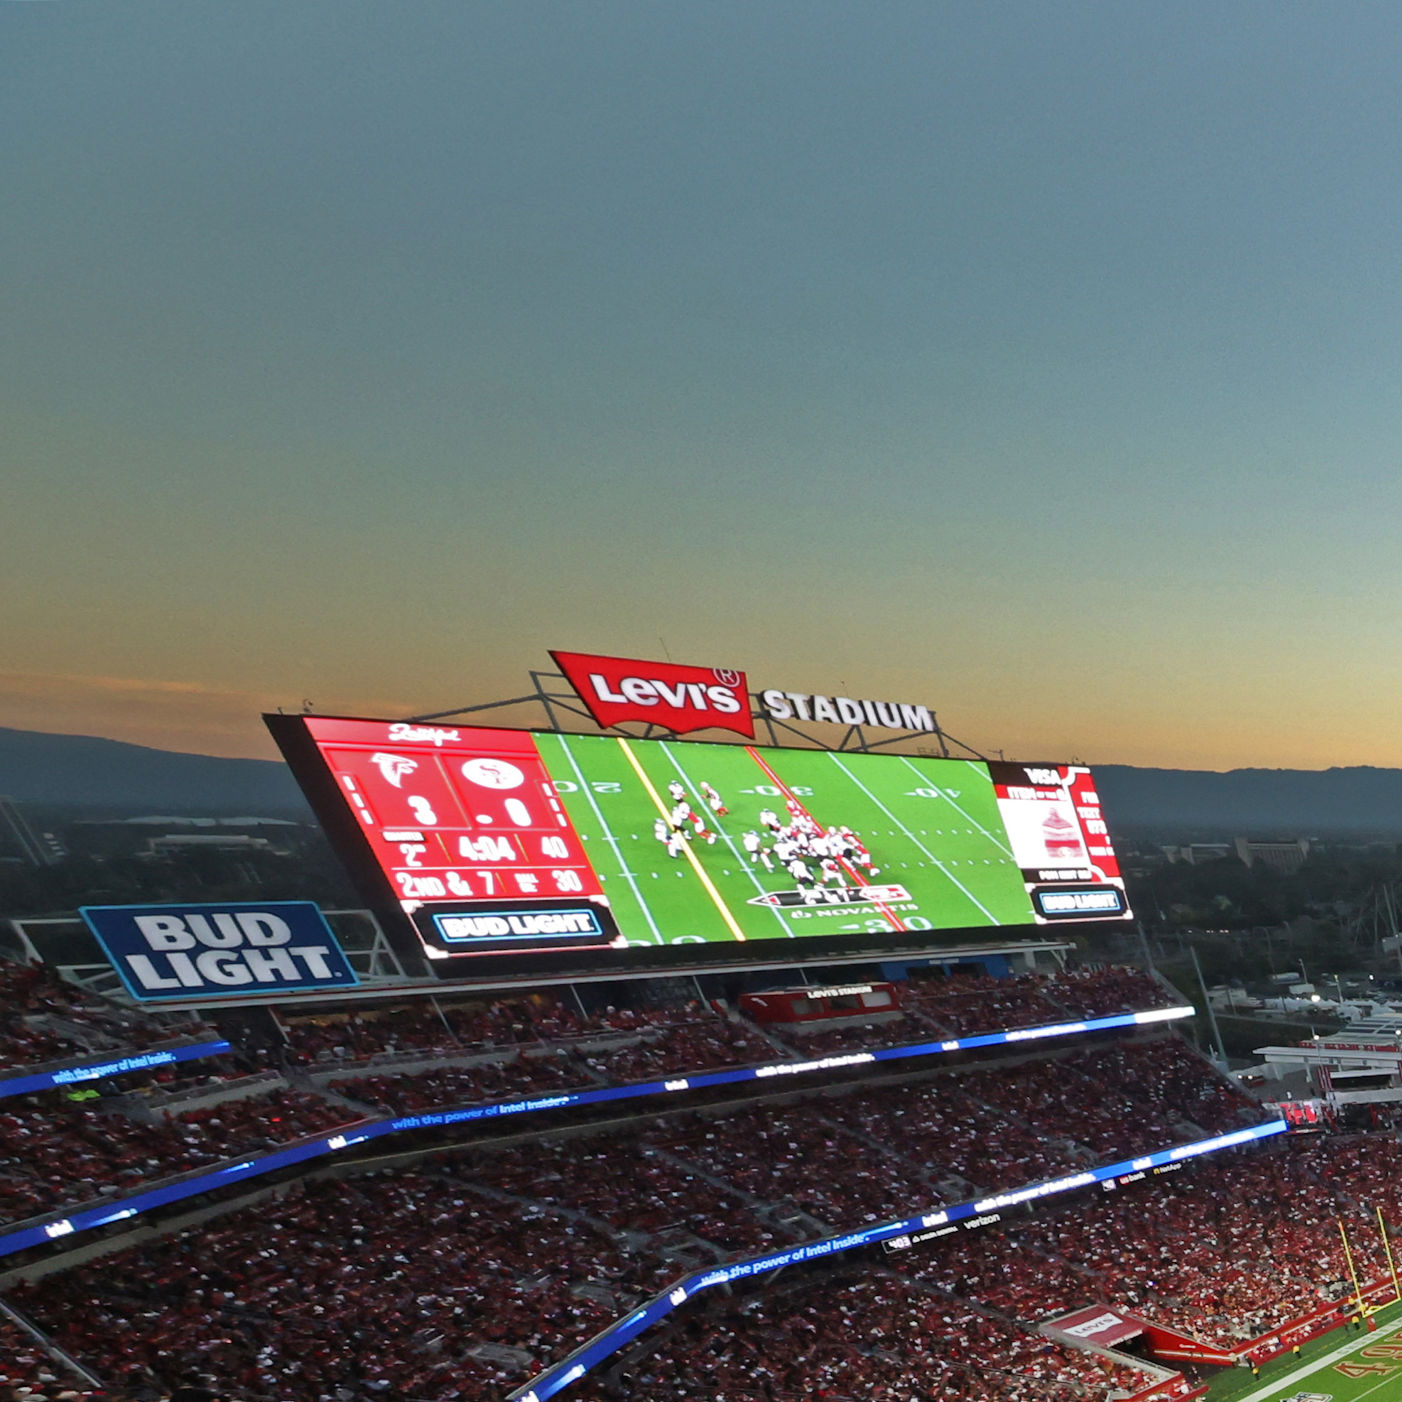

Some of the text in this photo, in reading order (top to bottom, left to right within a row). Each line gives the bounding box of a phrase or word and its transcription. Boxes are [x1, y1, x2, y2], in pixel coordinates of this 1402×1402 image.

[762, 689, 935, 732] STADIUM
[396, 872, 446, 897] 2ND
[477, 871, 495, 895] 7
[552, 870, 583, 892] 30
[133, 911, 293, 952] BUD
[441, 914, 594, 938] BUD LIGHT
[125, 945, 333, 991] LIGHT
[392, 1117, 420, 1130] with
[422, 1114, 443, 1126] the
[445, 1109, 482, 1125] power
[485, 1106, 498, 1117] of
[499, 1101, 525, 1115] Intel
[964, 1213, 1001, 1229] verizon
[889, 1236, 911, 1249] 403
[701, 1269, 728, 1286] with
[730, 1261, 751, 1278] the
[753, 1253, 791, 1275] power
[792, 1247, 804, 1261] of
[806, 1240, 831, 1258] Intel
